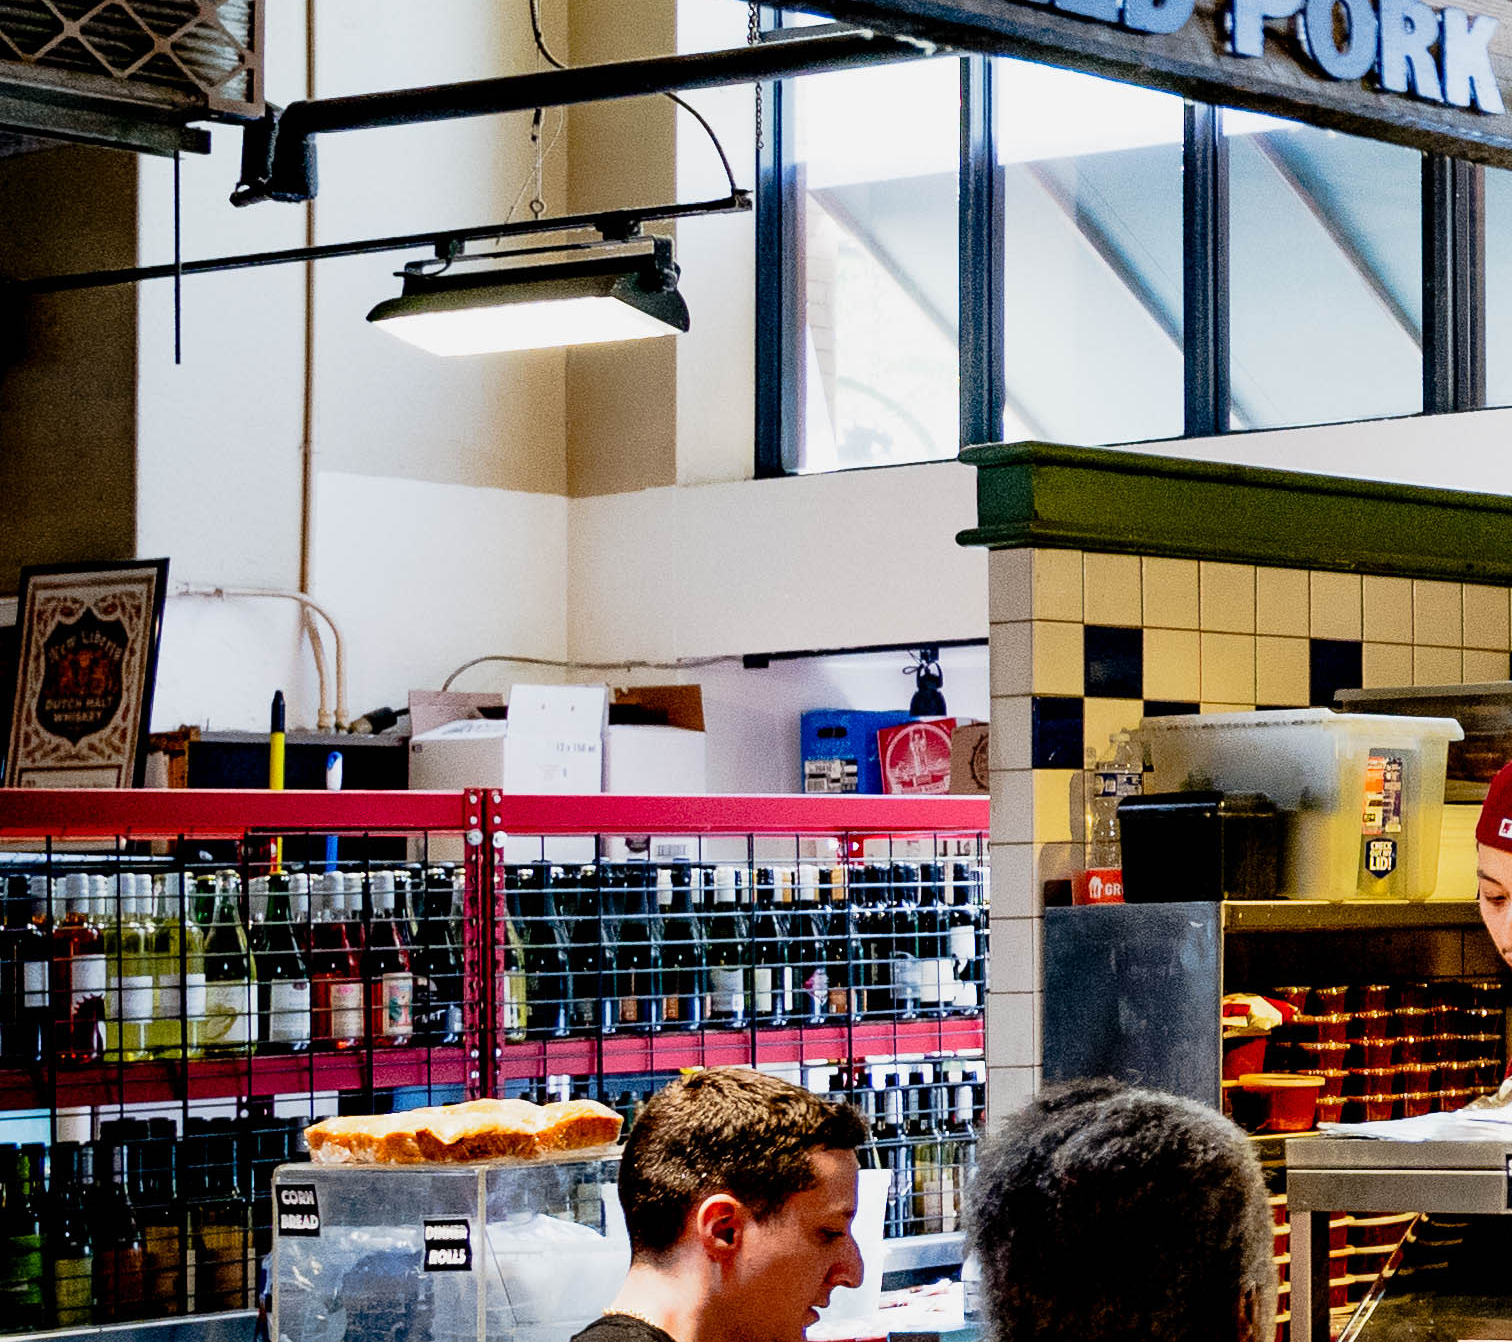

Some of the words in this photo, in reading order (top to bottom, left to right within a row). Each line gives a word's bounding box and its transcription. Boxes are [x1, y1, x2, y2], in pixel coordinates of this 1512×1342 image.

[281, 1190, 315, 1205] CORN
[281, 1214, 319, 1230] BREAD
[428, 1249, 466, 1265] ROLLS
